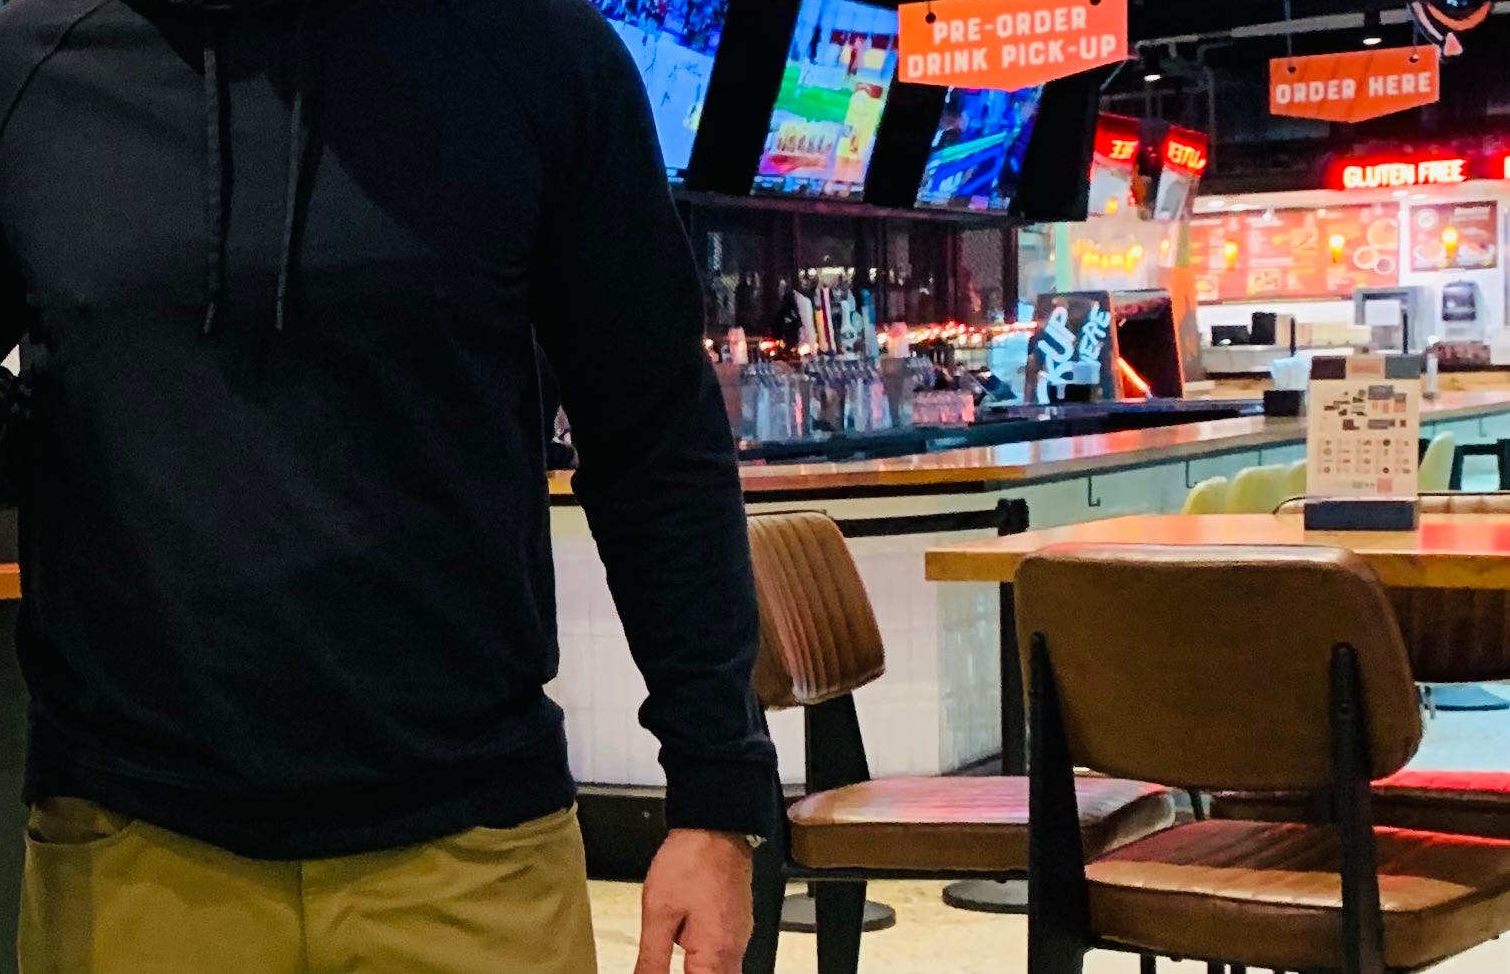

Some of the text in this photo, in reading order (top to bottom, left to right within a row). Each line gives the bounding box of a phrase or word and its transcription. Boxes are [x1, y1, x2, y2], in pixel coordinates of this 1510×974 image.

[933, 6, 1087, 45] PRE-ORDER
[908, 34, 1117, 79] DRINK PICK-UP
[1275, 72, 1431, 104] ORDER HERE
[1343, 159, 1467, 189] GLUTEN FREE
